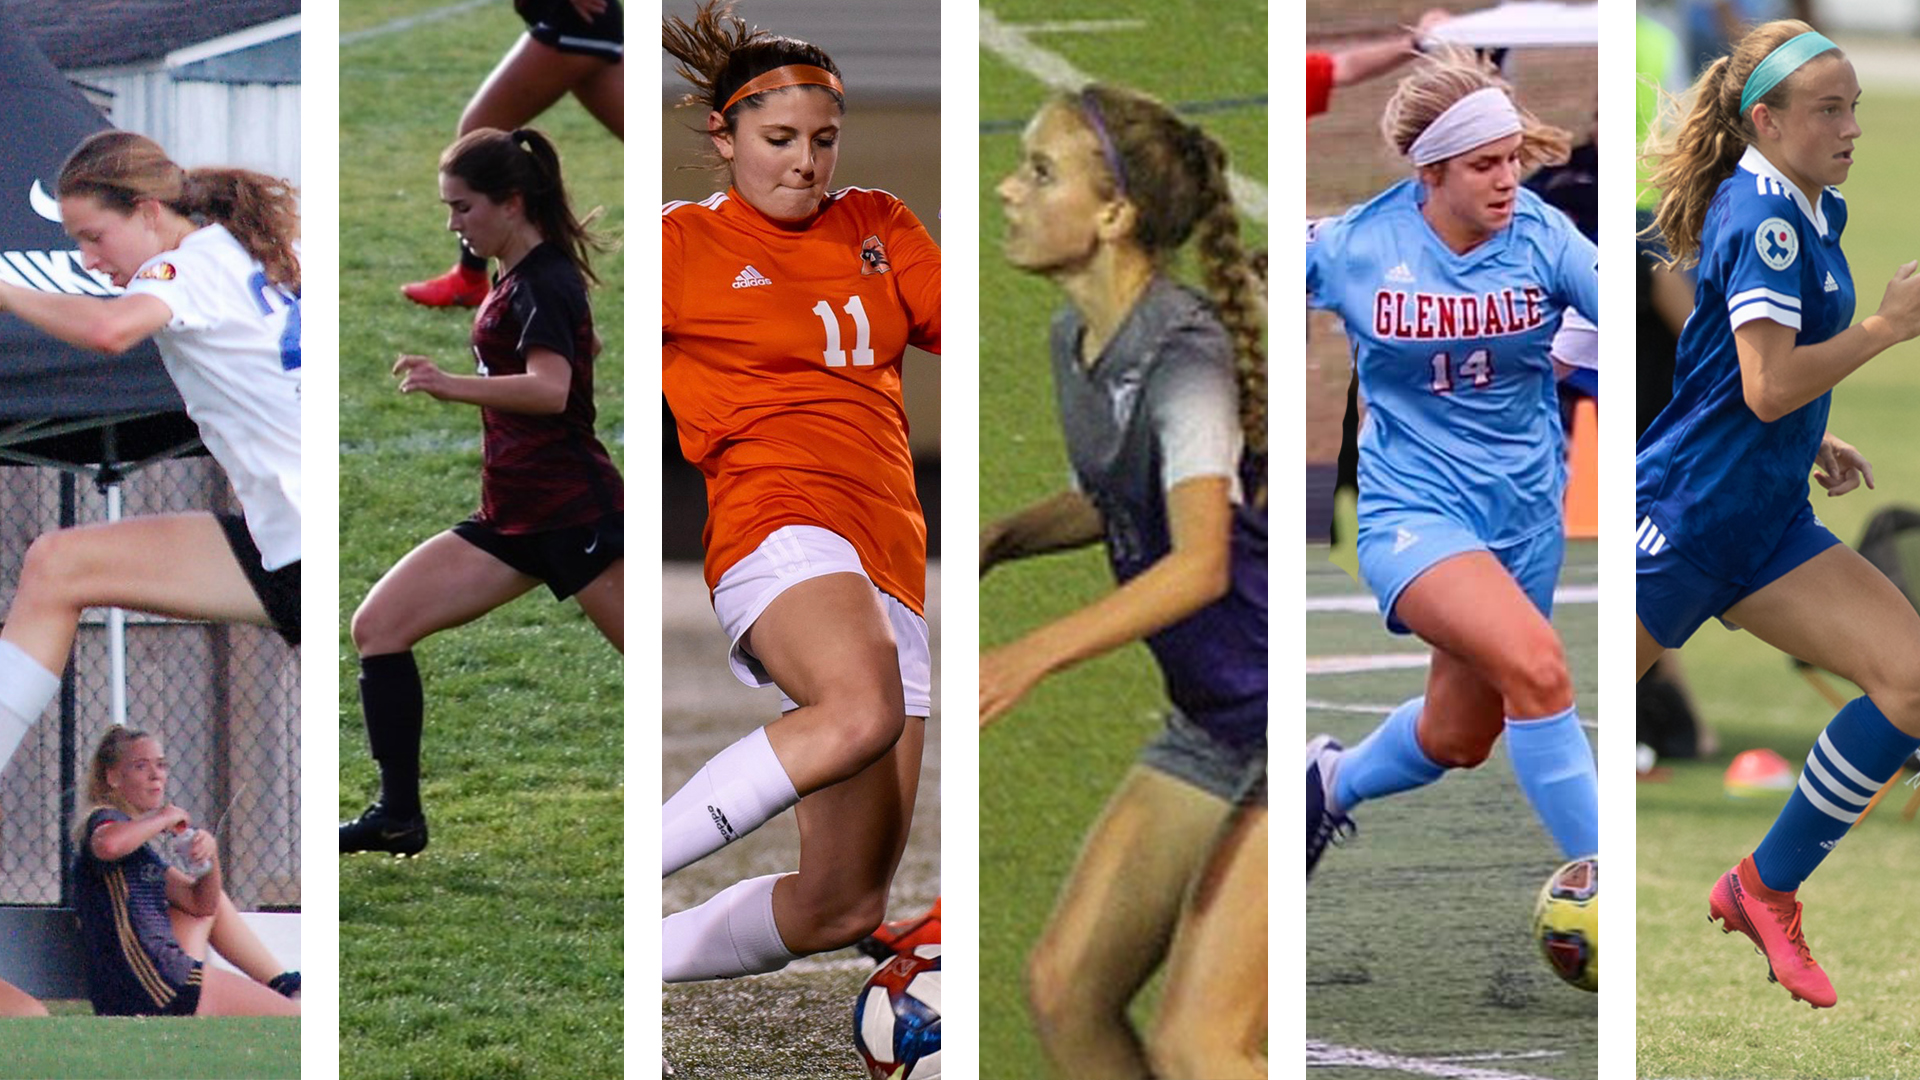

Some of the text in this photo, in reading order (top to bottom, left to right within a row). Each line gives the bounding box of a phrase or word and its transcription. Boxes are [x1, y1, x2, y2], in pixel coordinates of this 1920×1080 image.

[731, 277, 772, 289] adidas
[811, 295, 874, 367] 11
[1373, 286, 1543, 341] GLENDALE
[1430, 348, 1493, 395] 14
[707, 804, 731, 841] adidas
